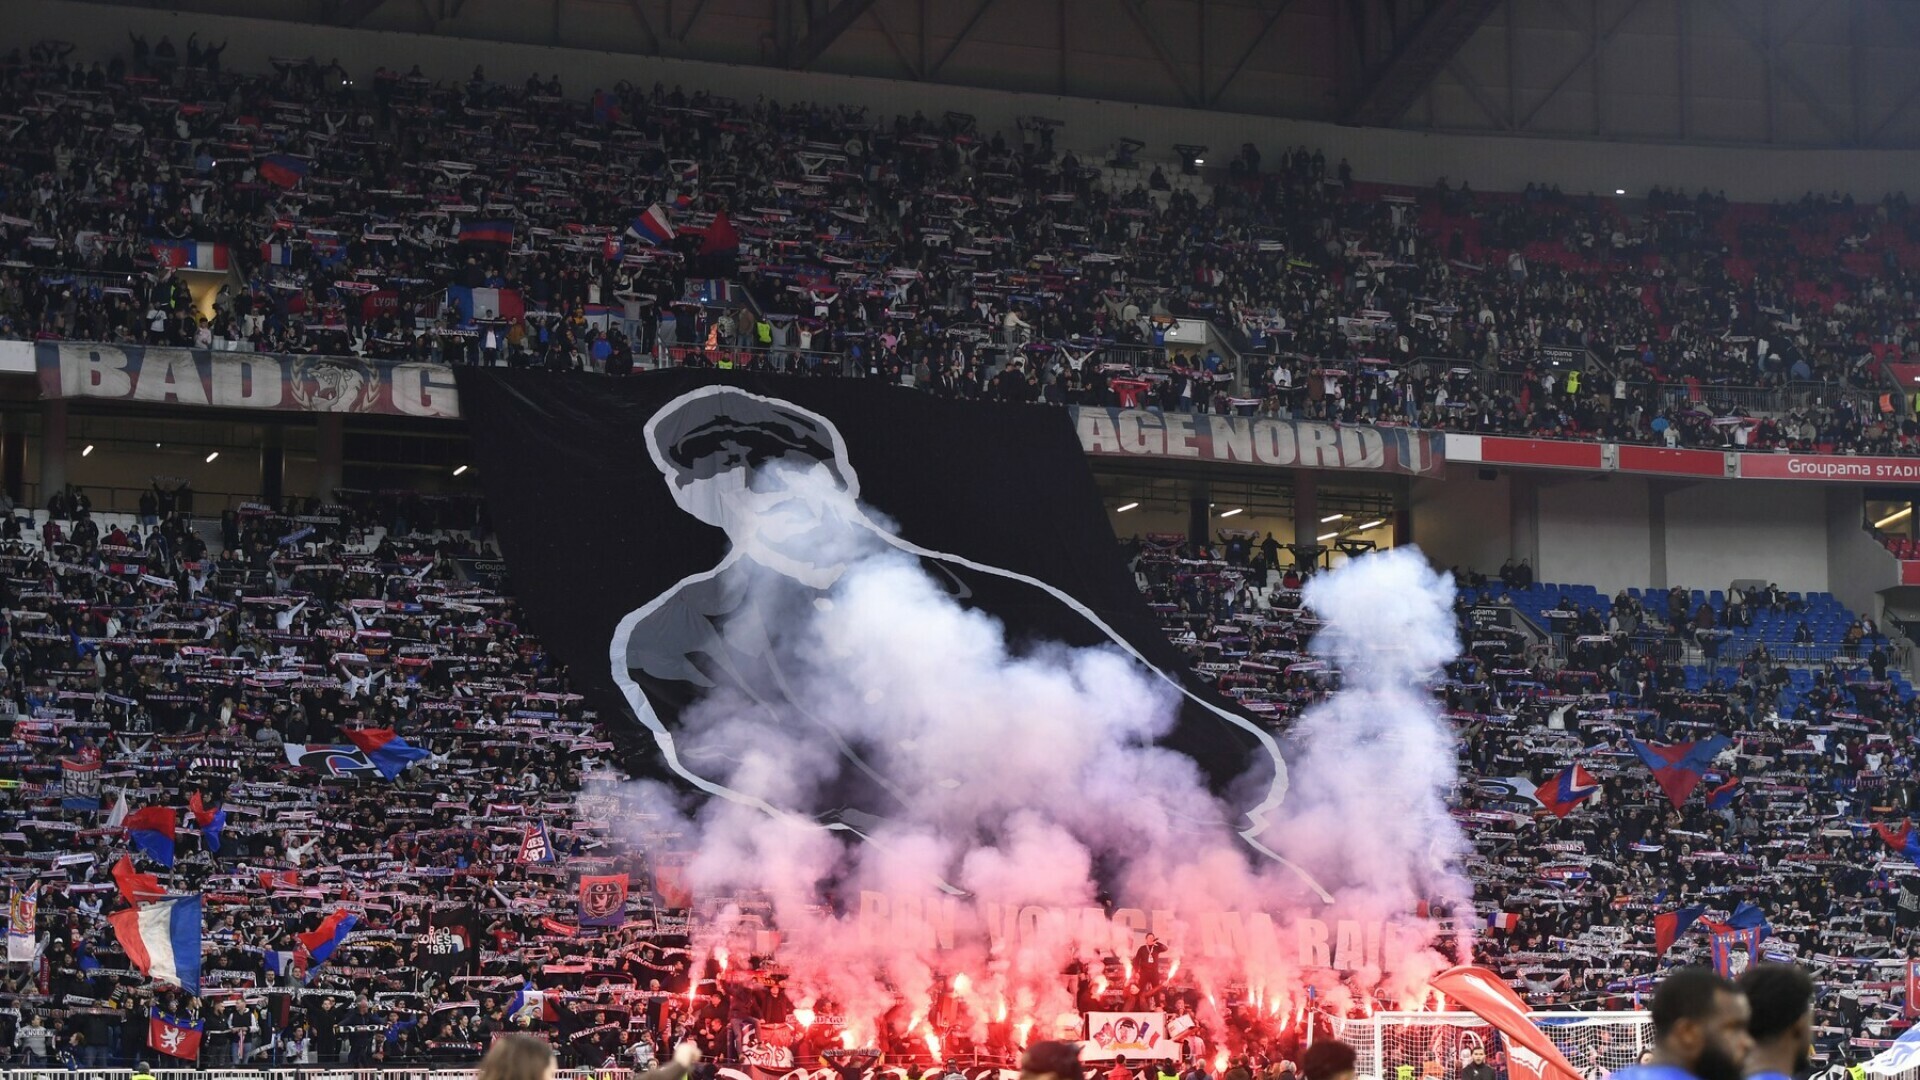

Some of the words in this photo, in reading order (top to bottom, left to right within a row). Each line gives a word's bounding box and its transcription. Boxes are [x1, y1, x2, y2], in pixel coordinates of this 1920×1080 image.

[59, 344, 283, 408] BAD
[1077, 409, 1200, 457] AGE
[1208, 415, 1386, 469] NORD
[1787, 458, 1871, 477] Groupama
[1876, 465, 1920, 477] STADI
[1470, 609, 1497, 618] upama
[595, 883, 612, 892] OL
[417, 934, 452, 945] GONES
[426, 944, 453, 955] 1987
